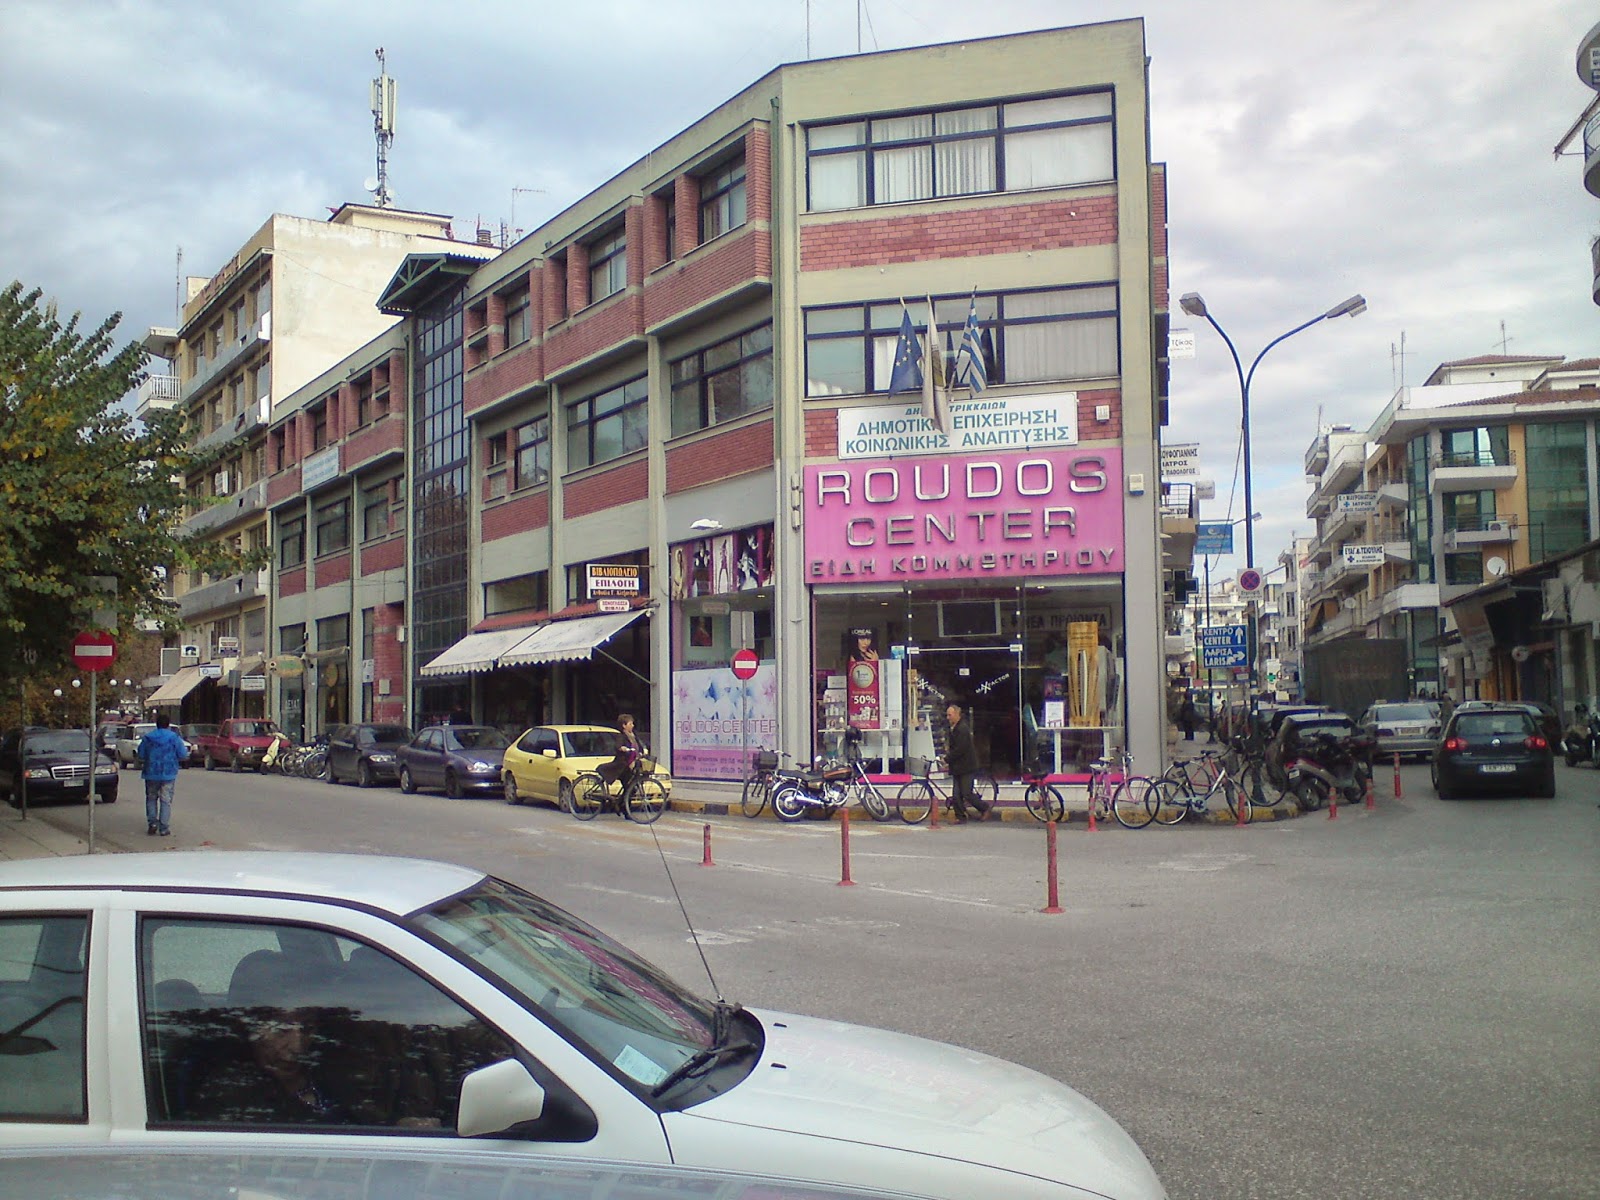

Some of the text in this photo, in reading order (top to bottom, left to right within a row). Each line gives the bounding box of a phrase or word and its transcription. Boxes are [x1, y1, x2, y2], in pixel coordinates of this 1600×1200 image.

[949, 401, 1007, 413] ΤΡΙΚΚΑΙΩΝ
[953, 409, 1058, 430] ΕΠΙΧΕΙΡΗΣΗ
[845, 426, 1070, 454] ΚΟΙΝΩΝΙΚΗΣ ΑΝΑΠΤΥΞΗΣ
[817, 456, 1109, 506] ROUDOS
[846, 506, 1077, 548] CENTER
[811, 548, 1115, 576] ΕΙΔΗ ΚΟΜΜΩΤΗΡΙΟΥ
[591, 566, 638, 577] ΒΙΒΛΙΟΠΩΛΕΙΟ
[595, 579, 635, 588] ΕΠΙΛΟΓΗ
[1204, 627, 1233, 636] ΚΕΝΤΡΟ
[1204, 636, 1232, 646] CENTER
[1204, 648, 1233, 657] ΛΑΡΙΣΑ
[853, 695, 876, 705] 50%
[675, 719, 777, 734] ROUDOS CENTER
